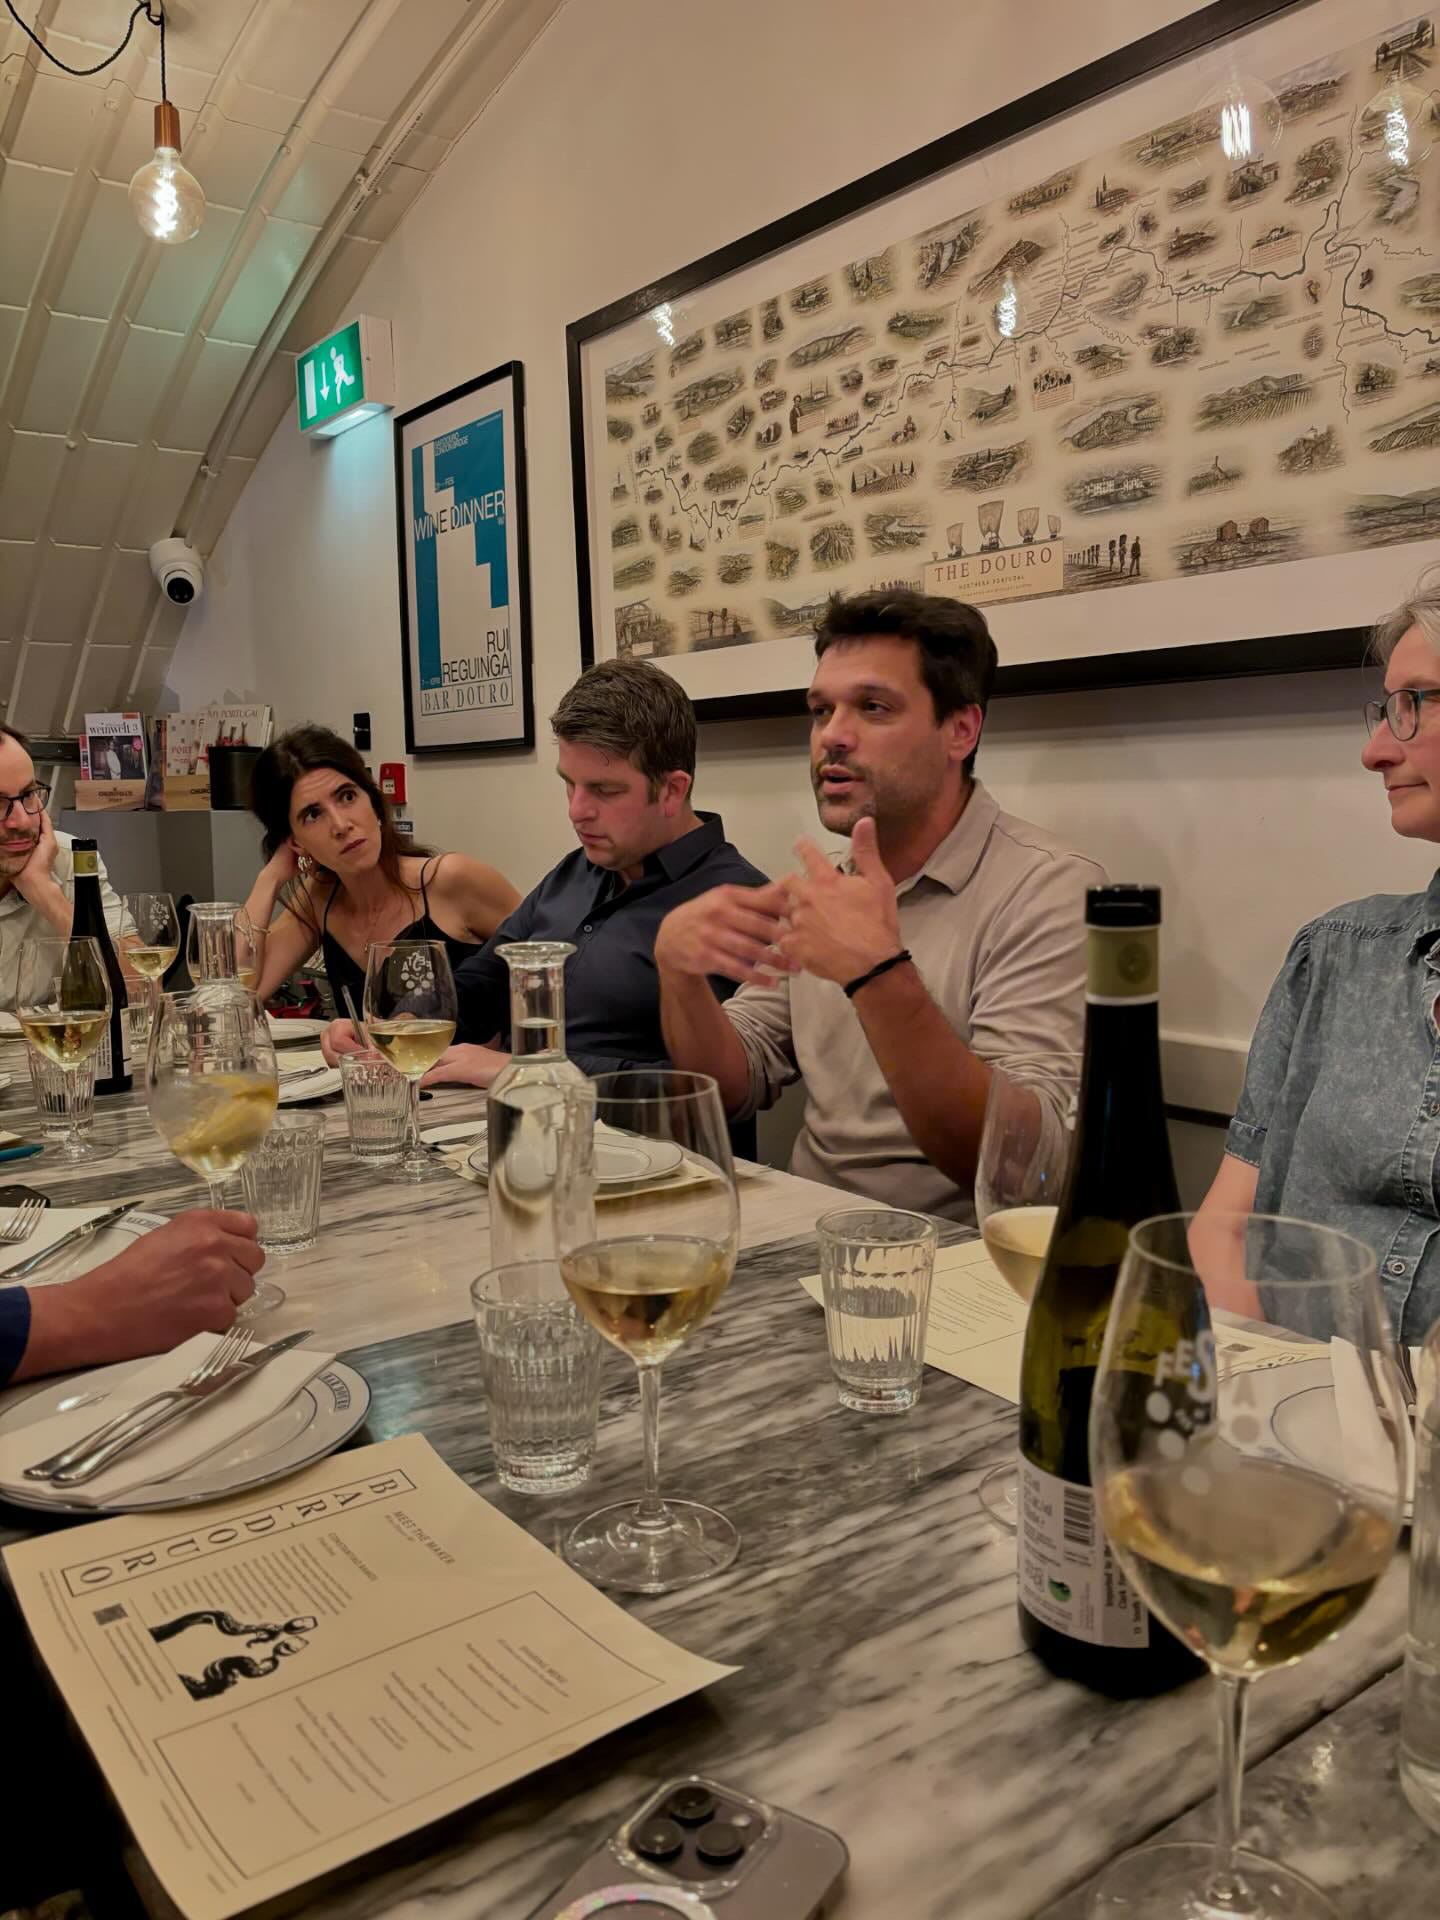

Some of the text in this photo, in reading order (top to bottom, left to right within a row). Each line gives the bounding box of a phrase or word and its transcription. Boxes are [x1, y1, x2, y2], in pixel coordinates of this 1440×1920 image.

[413, 489, 505, 541] WINE DINNER
[934, 547, 1052, 582] THE DOURO
[486, 627, 509, 653] RUI
[442, 653, 511, 684] REGUINGA
[424, 682, 509, 712] BAR DOURO
[297, 1478, 398, 1519] BAR
[79, 1514, 277, 1585] DOURO
